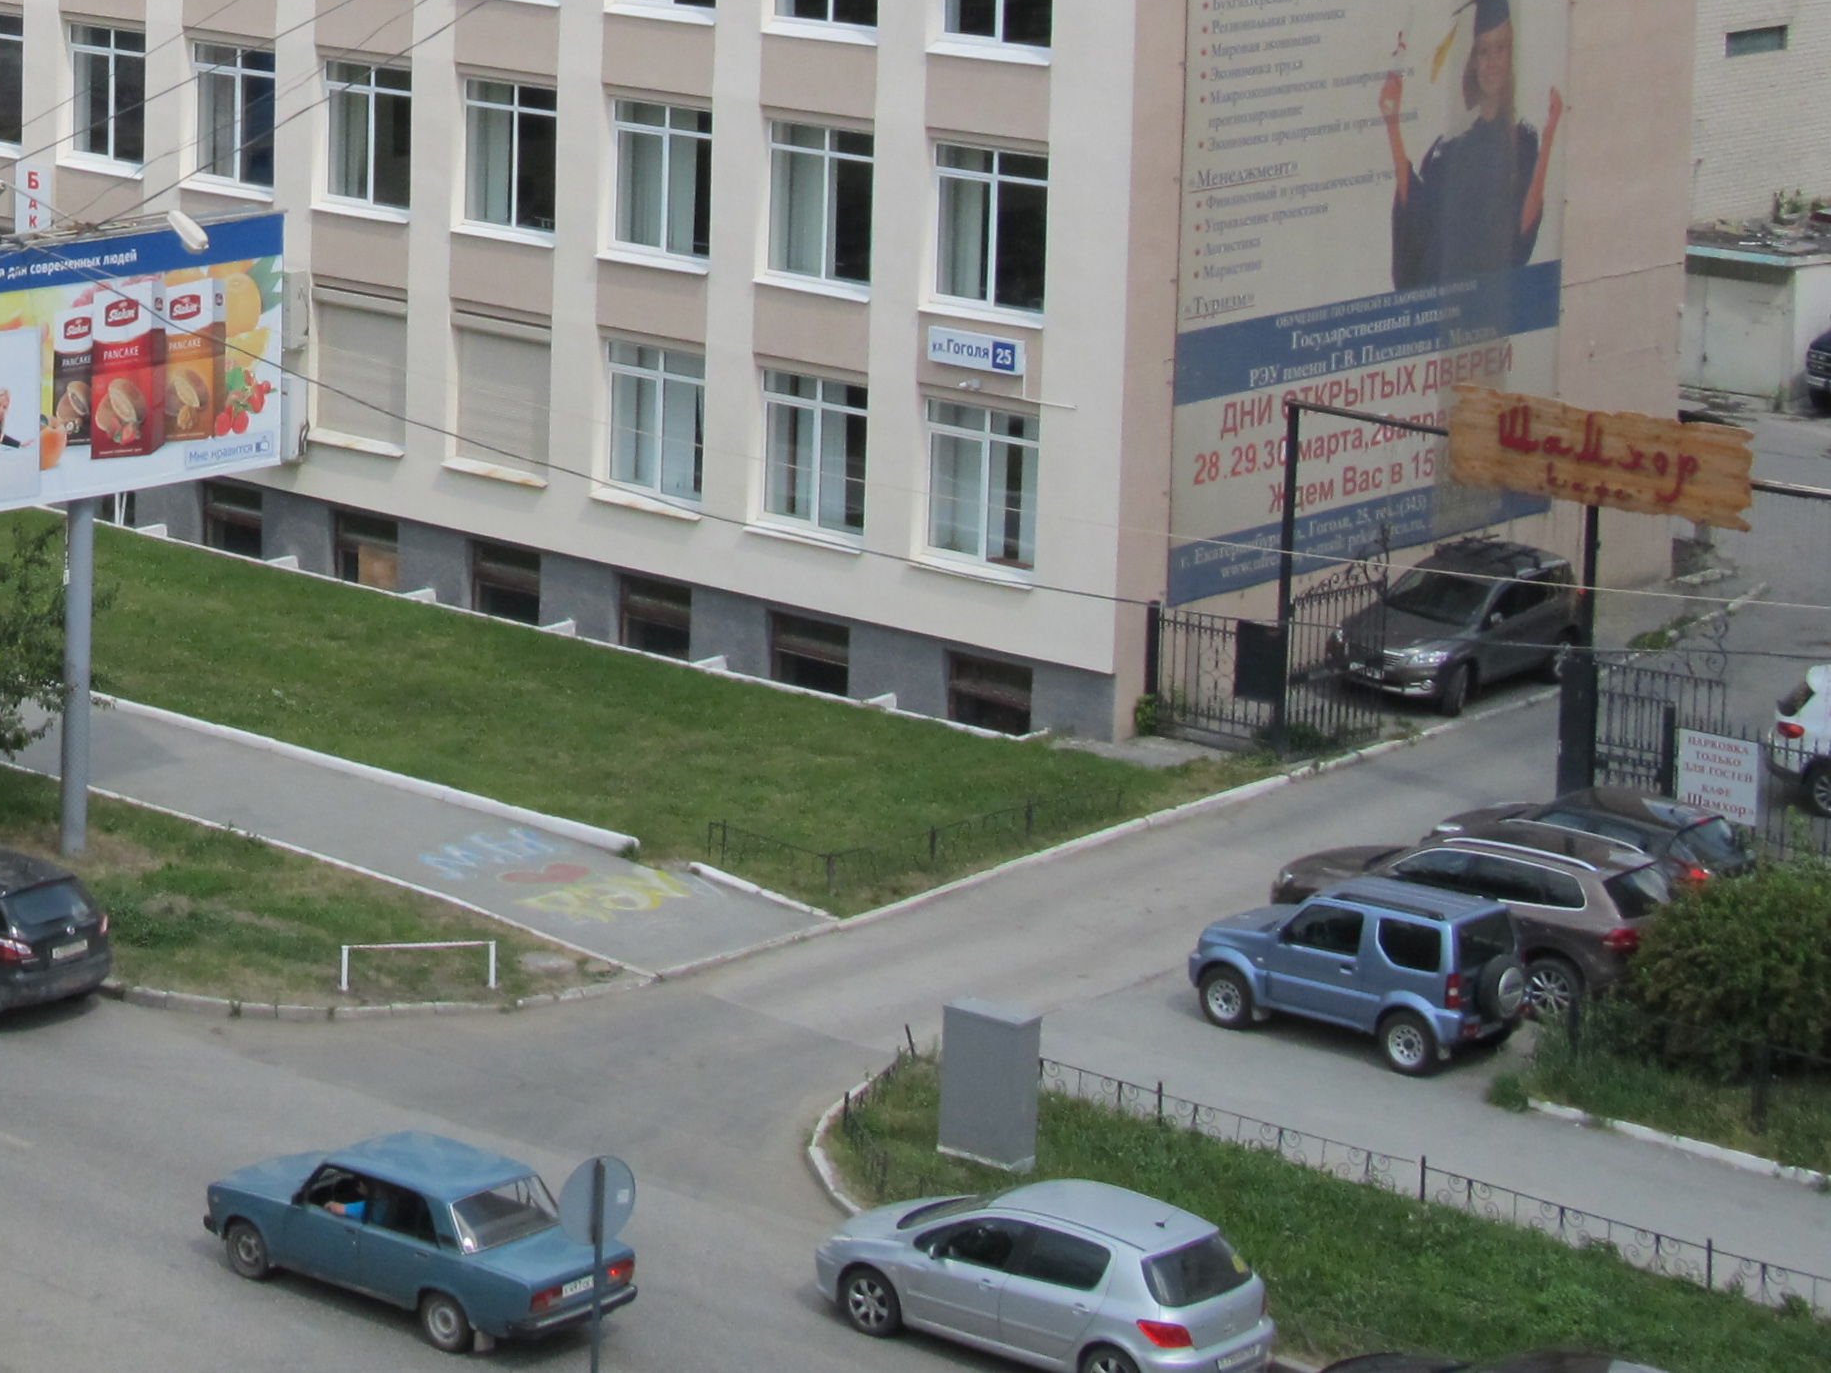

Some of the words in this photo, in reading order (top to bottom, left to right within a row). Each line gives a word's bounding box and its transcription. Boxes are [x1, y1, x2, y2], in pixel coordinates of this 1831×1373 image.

[29, 254, 101, 277] современных
[102, 248, 139, 267] людей
[1291, 310, 1411, 351] Государственный
[103, 345, 140, 361] PANCAKE
[168, 337, 202, 351] PANCAKE
[61, 354, 92, 367] PANCAKE
[995, 348, 1013, 365] 25
[1249, 364, 1280, 388] РЭУ
[1283, 360, 1327, 380] имени
[1361, 337, 1432, 366] Плеханова
[1220, 393, 1273, 441] ДНИ
[1281, 363, 1417, 421] ОТКРЫТЫХ
[1421, 336, 1514, 397] ДВЕРЕЙ
[188, 450, 209, 463] Мне
[210, 443, 254, 461] нравится
[1342, 464, 1383, 497] Вас
[1389, 462, 1404, 485] в
[1687, 735, 1750, 756] ПАРКОВКА
[1695, 750, 1742, 767] ТОЛЬКО
[1683, 761, 1706, 774] ДЛЯ
[1709, 764, 1753, 784] ГОСТЕЙ
[1701, 783, 1732, 798] КАФЕ
